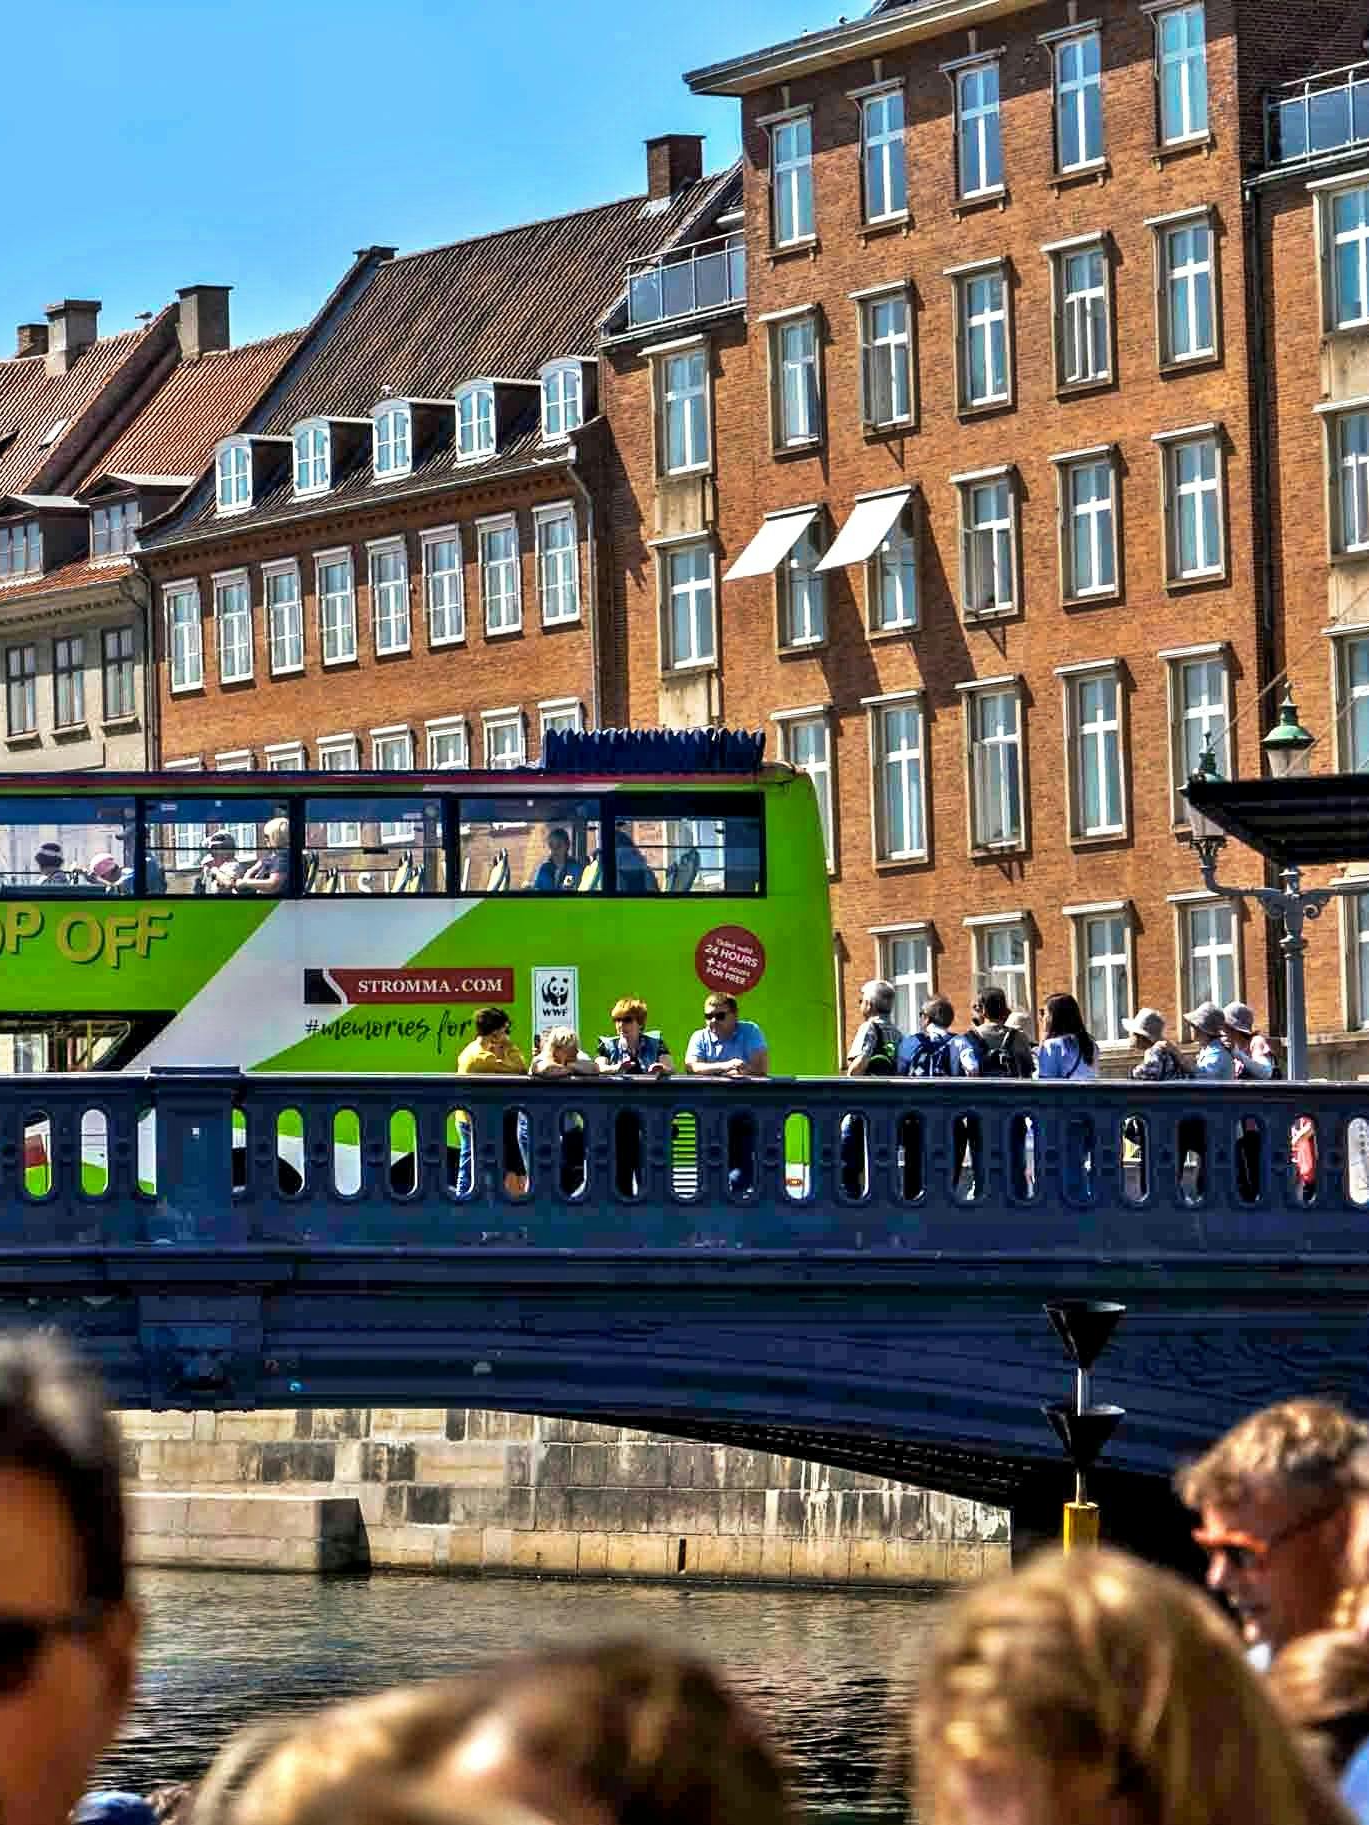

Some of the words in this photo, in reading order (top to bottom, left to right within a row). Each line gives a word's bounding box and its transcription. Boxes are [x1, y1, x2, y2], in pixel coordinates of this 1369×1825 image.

[57, 906, 174, 970] OFF
[704, 944, 719, 955] 24
[720, 948, 759, 968] HOURS
[705, 966, 724, 978] FOR
[543, 1007, 568, 1017] WWF
[305, 1015, 431, 1042] #memories
[435, 1009, 472, 1055] for
